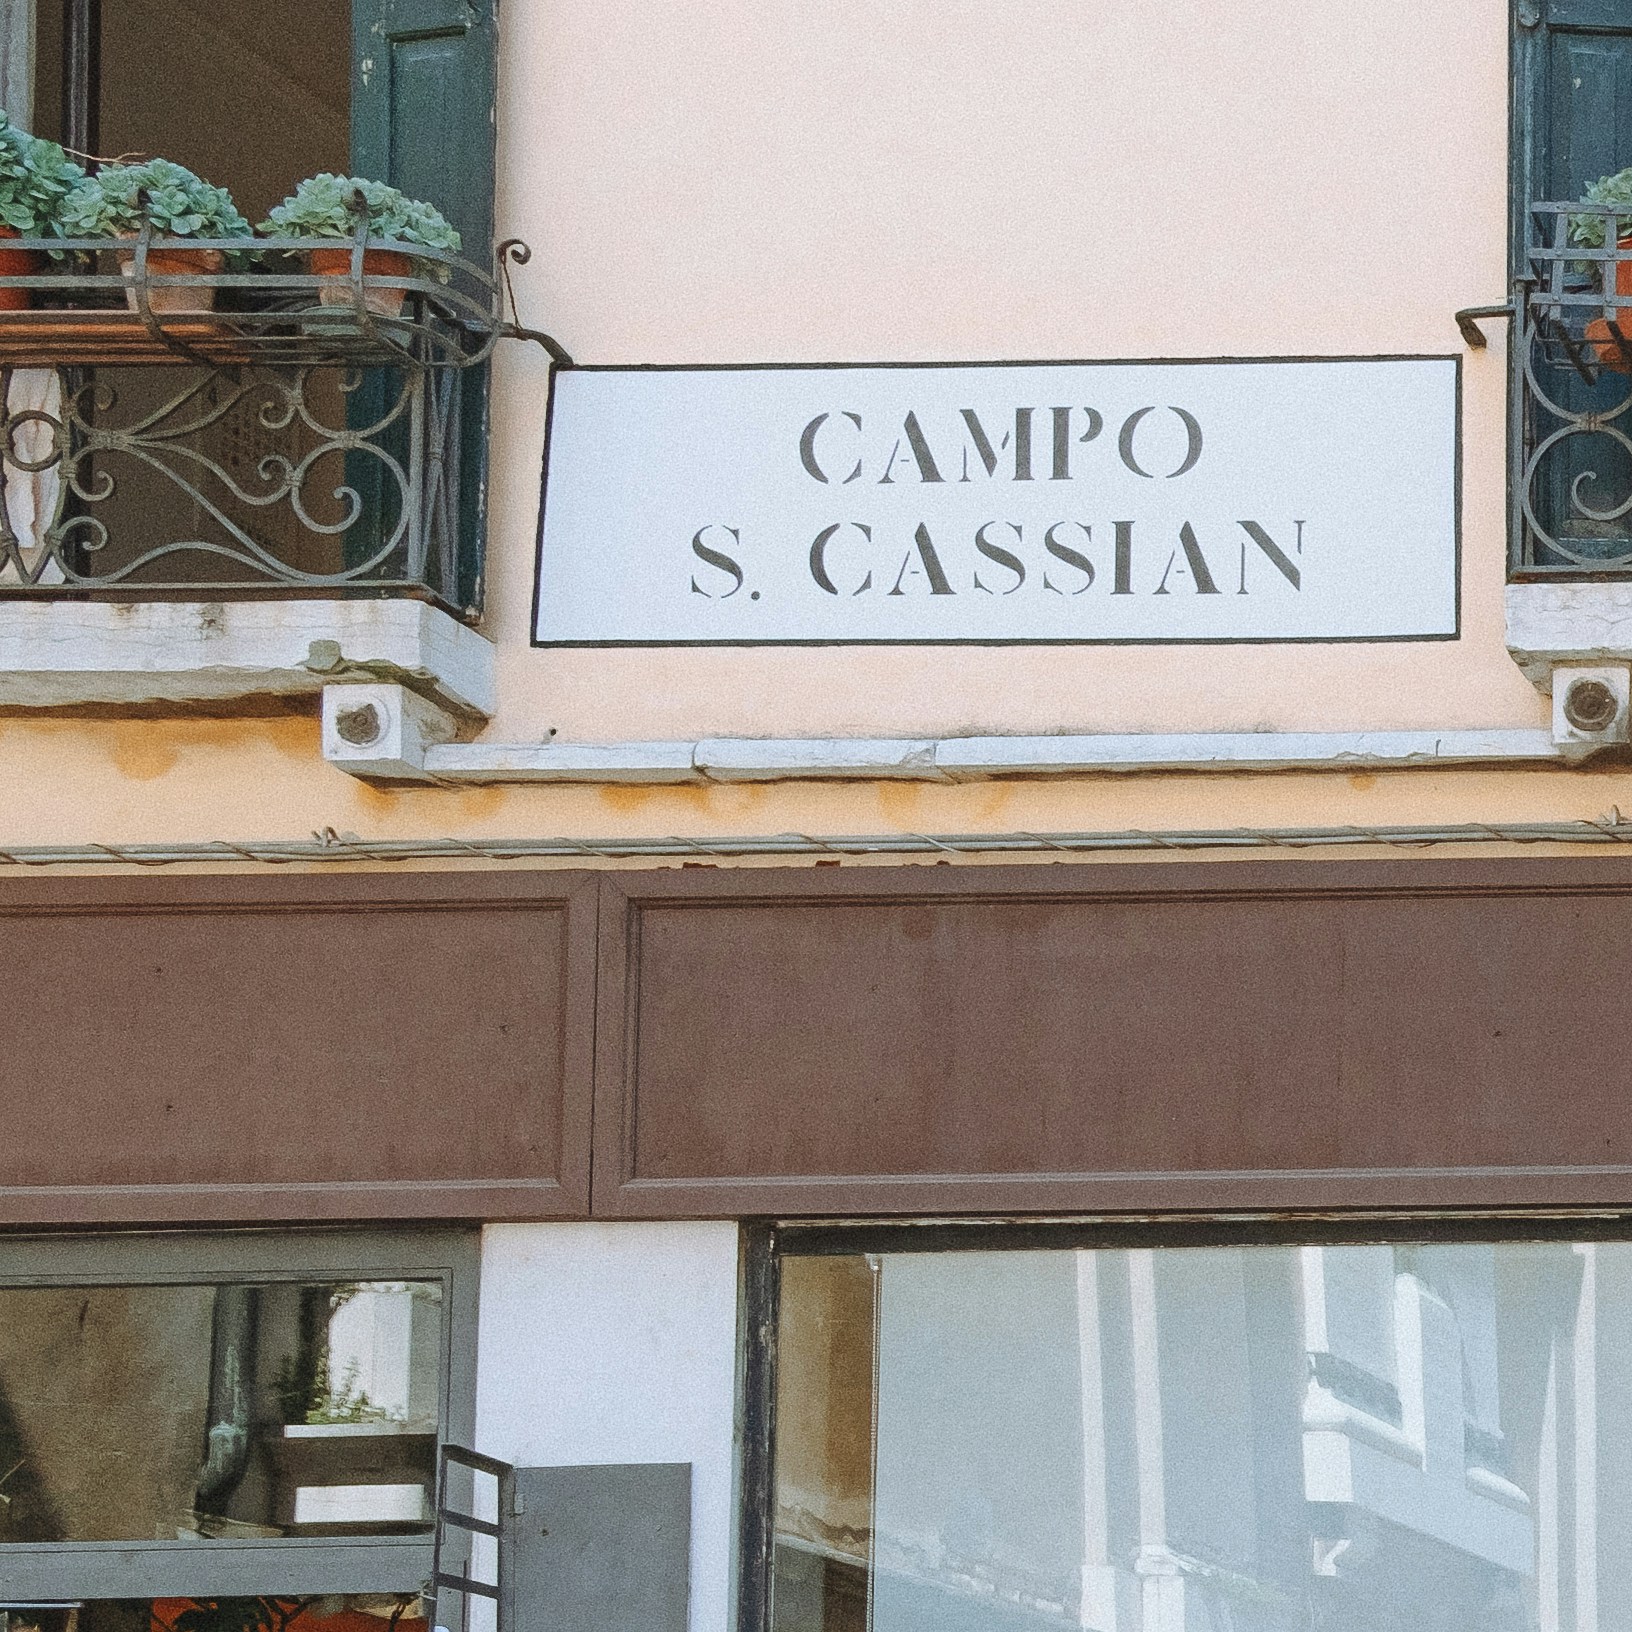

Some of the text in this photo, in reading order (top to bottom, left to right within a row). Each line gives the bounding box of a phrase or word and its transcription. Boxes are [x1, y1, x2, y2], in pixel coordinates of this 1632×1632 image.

[799, 406, 1204, 484] CAMPO
[690, 520, 1306, 601] S. CASSIAN
